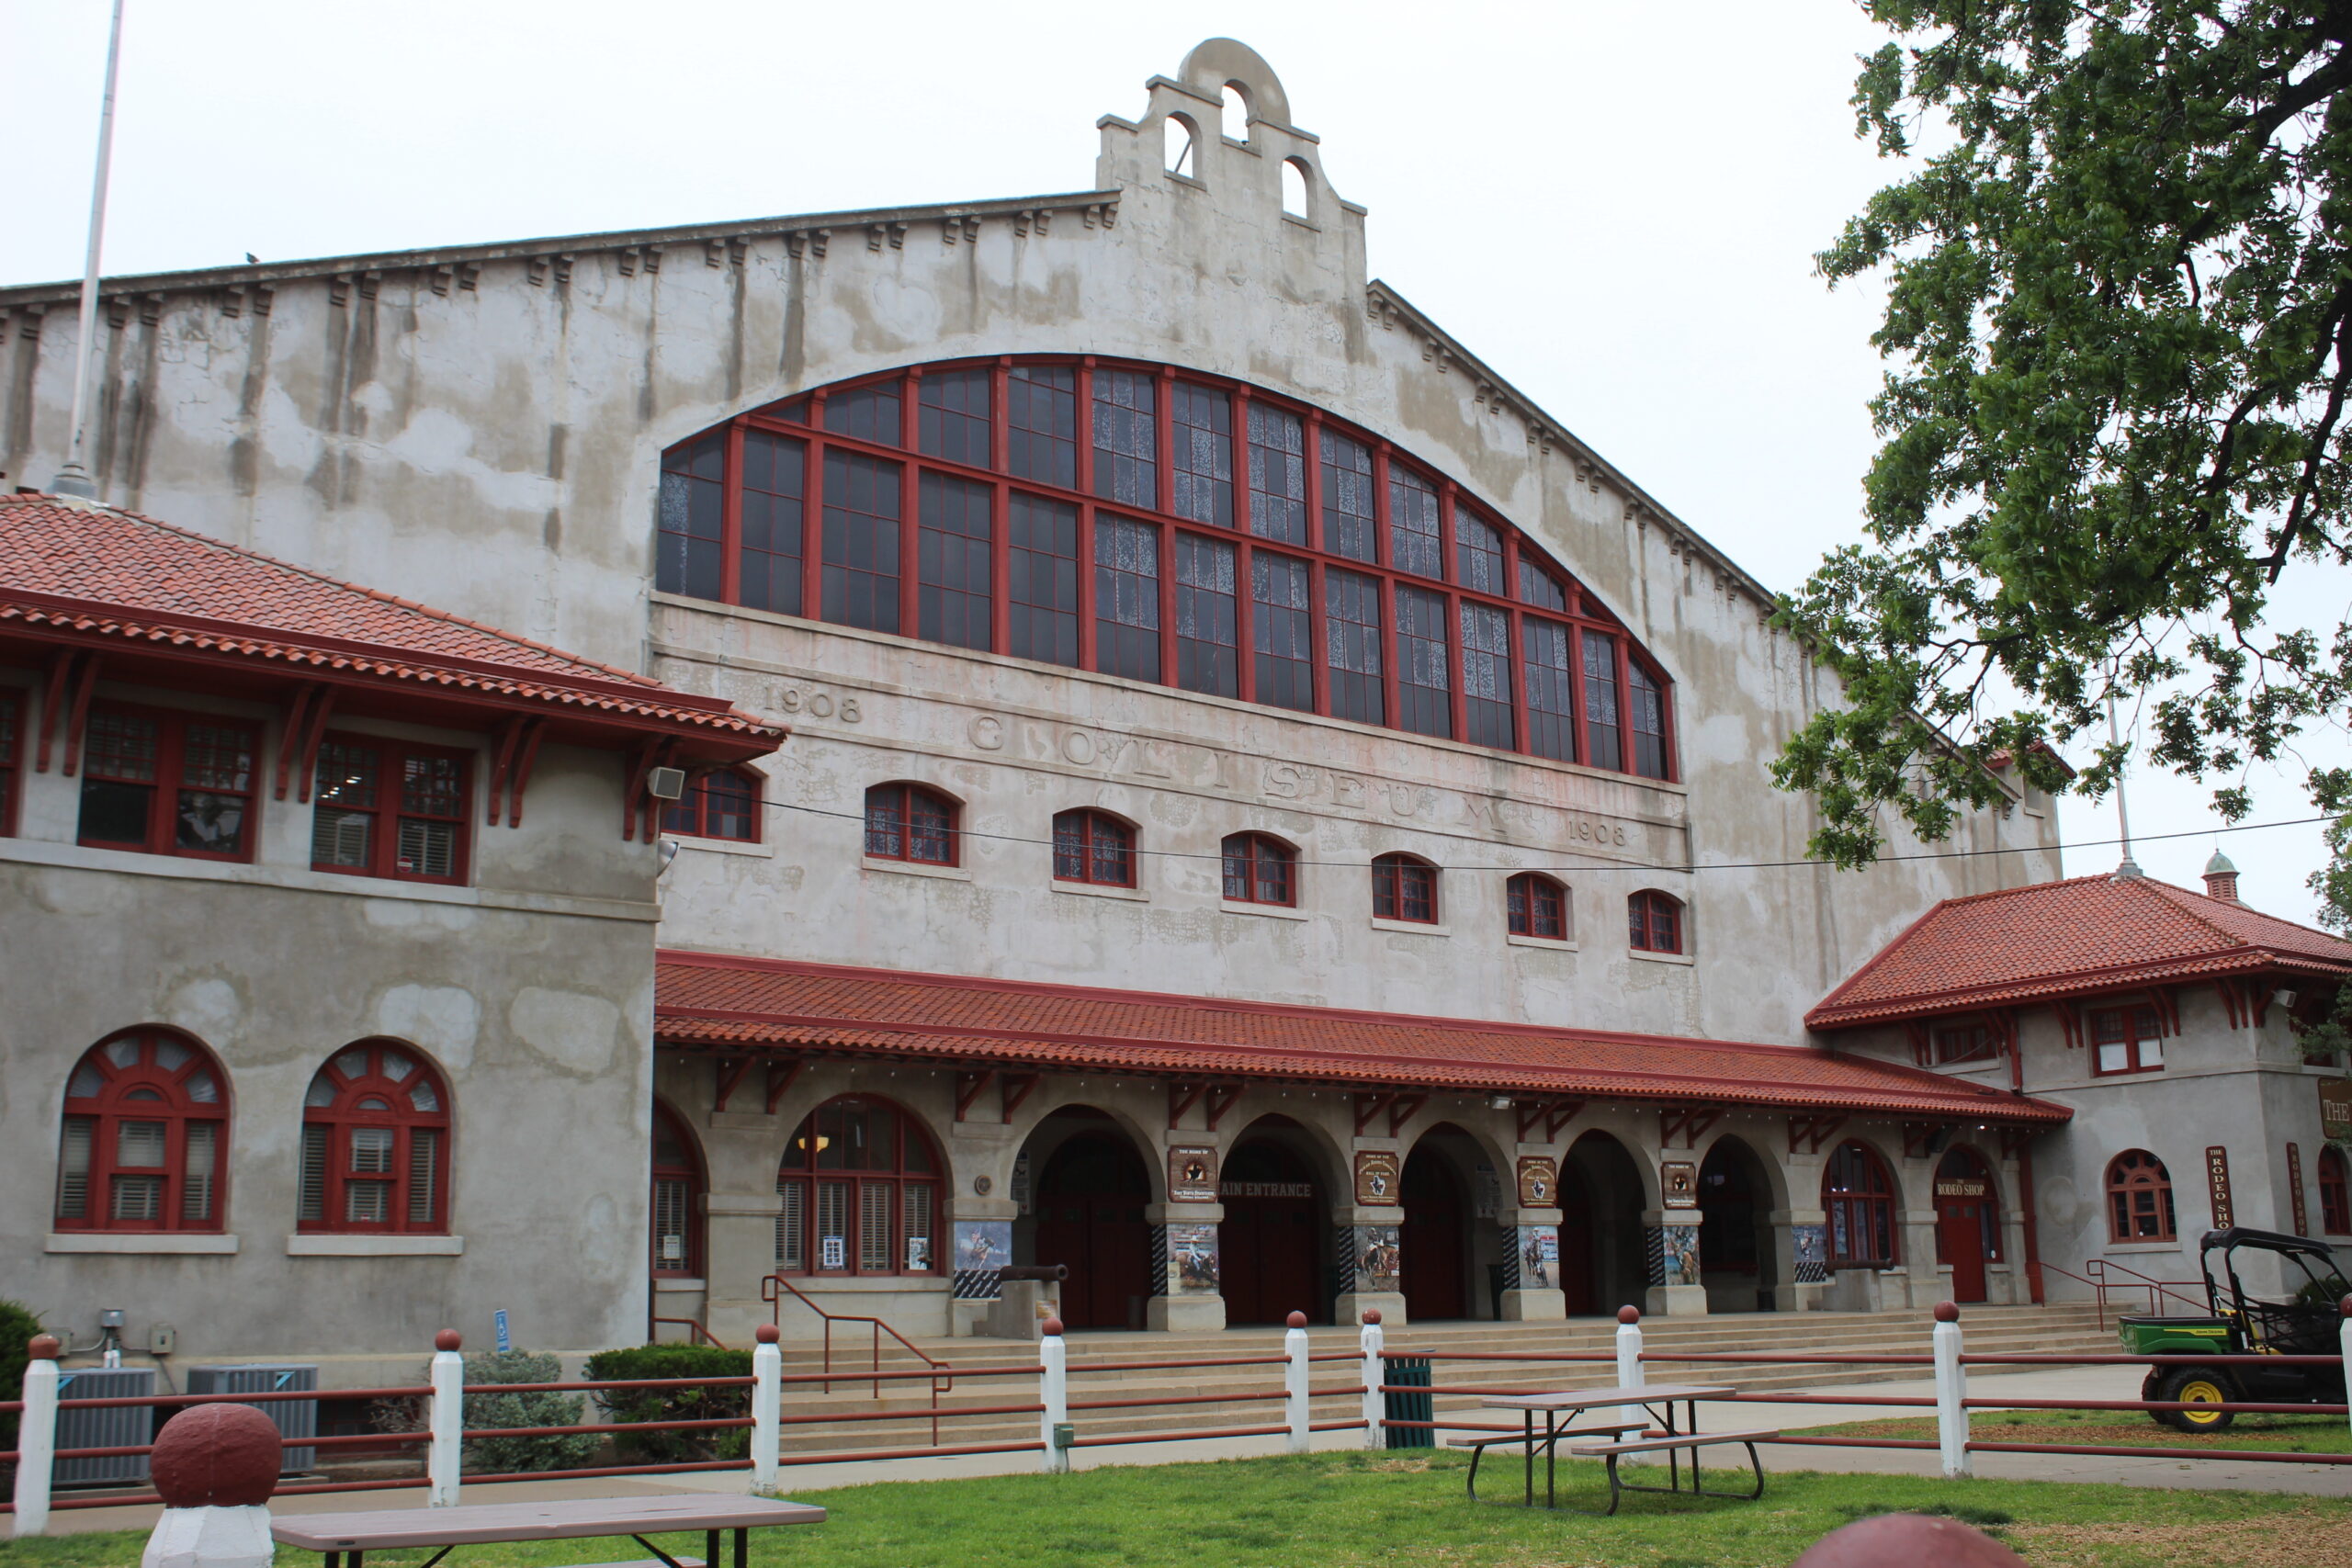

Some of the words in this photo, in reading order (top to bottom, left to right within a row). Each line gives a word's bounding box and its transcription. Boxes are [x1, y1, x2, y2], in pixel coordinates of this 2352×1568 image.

[763, 685, 864, 724] 1908
[967, 713, 1507, 834] COLISEUM
[1568, 820, 1627, 847] 1908
[2323, 1100, 2349, 1122] THE
[1219, 1182, 1242, 1196] AIN
[1246, 1182, 1311, 1197] ENTRANCE
[1938, 1183, 1962, 1195] RODEO
[1963, 1184, 1984, 1196] SHOP
[2212, 1158, 2226, 1201] RODEO
[2218, 1204, 2230, 1230] SHO
